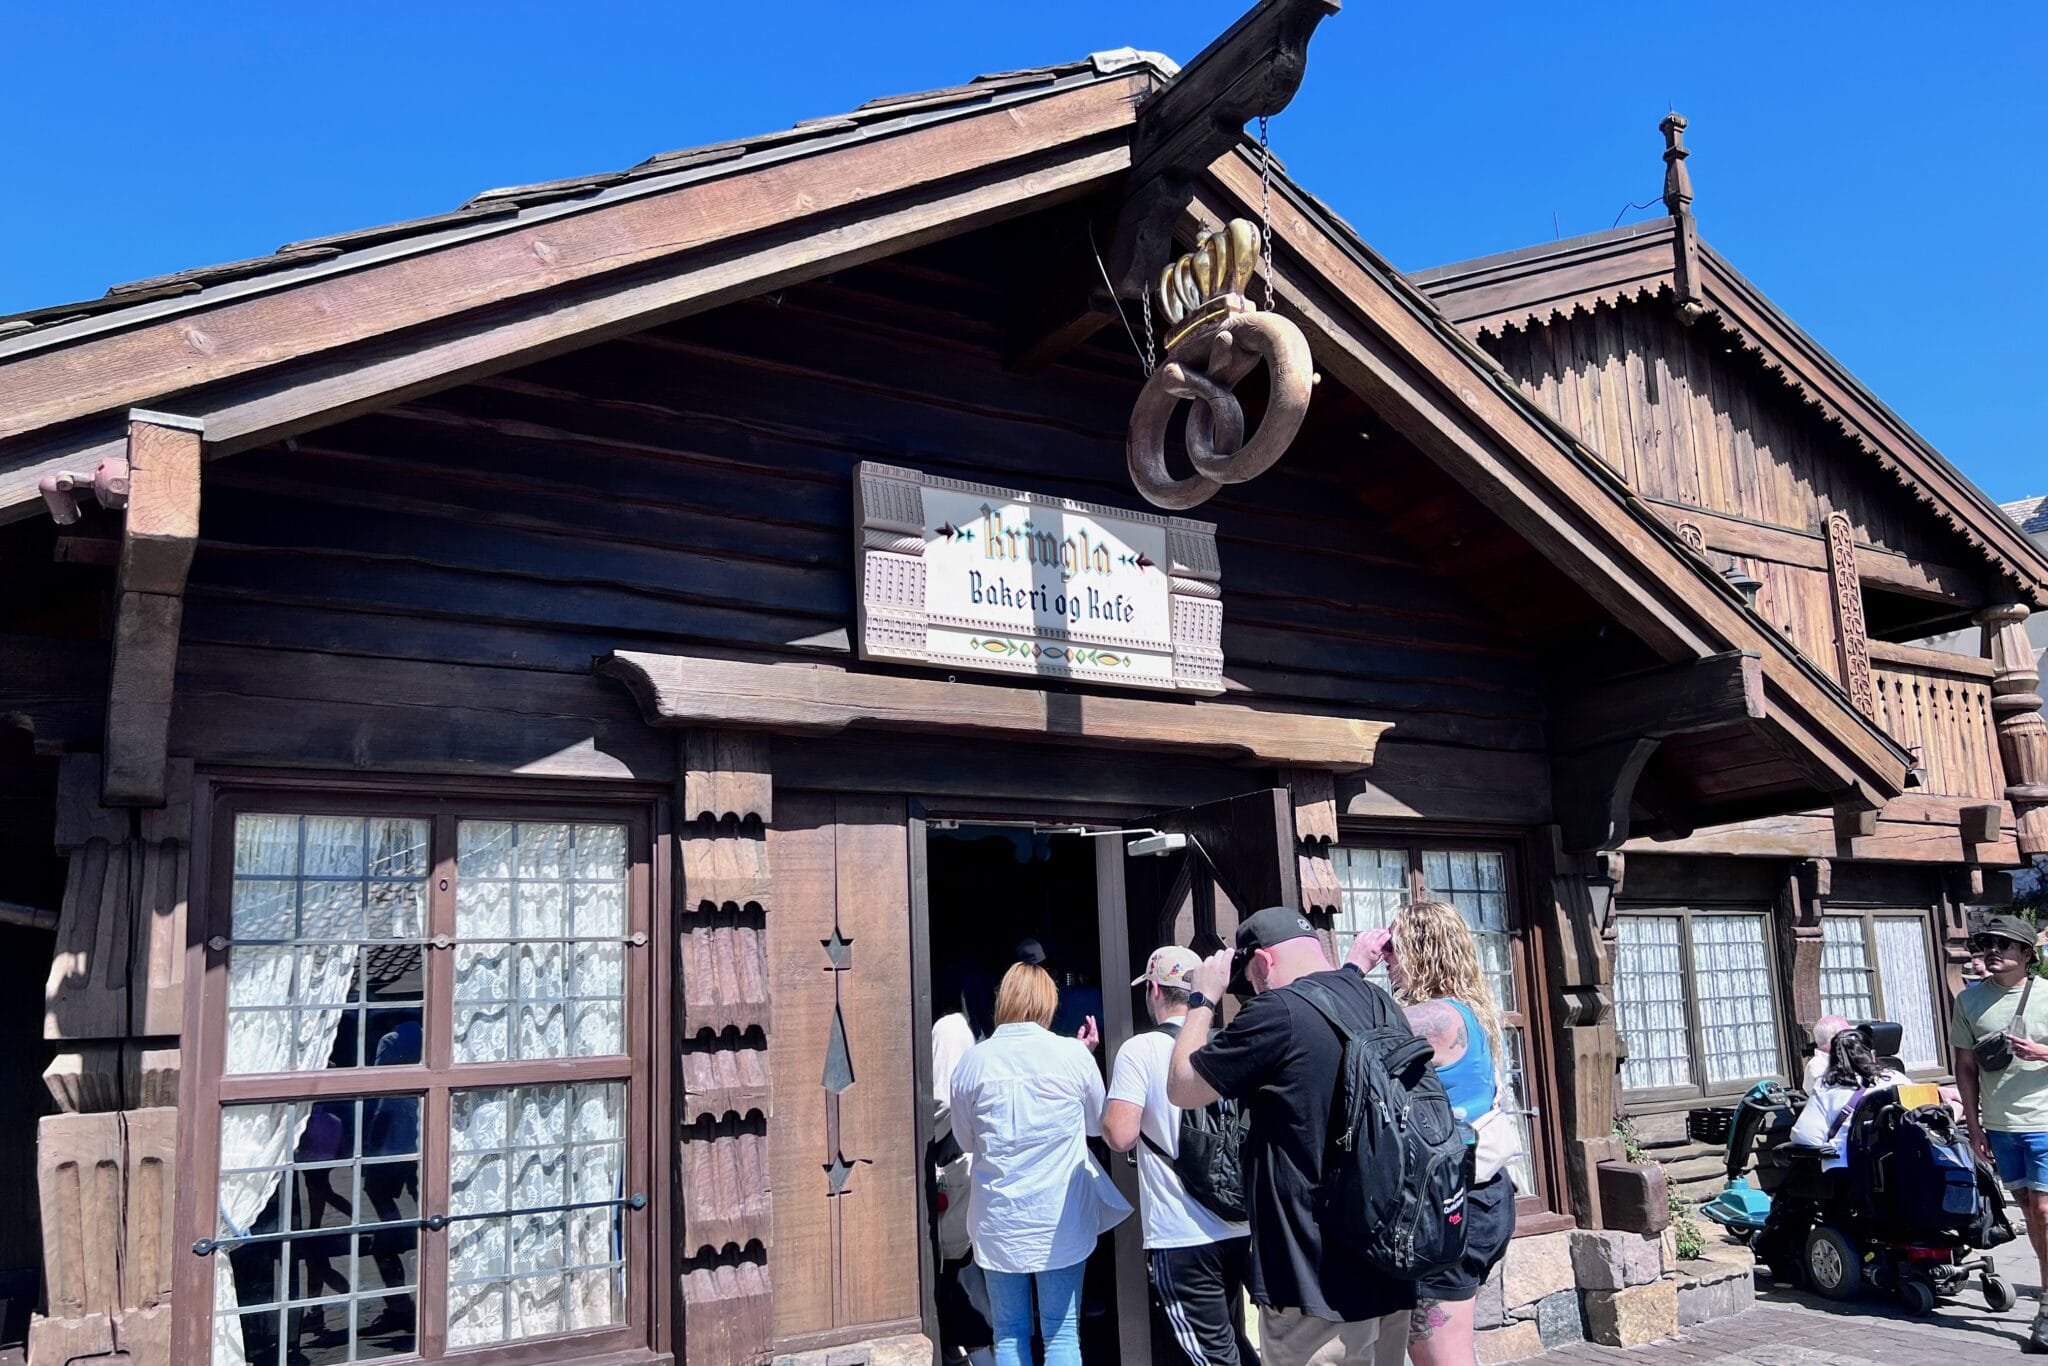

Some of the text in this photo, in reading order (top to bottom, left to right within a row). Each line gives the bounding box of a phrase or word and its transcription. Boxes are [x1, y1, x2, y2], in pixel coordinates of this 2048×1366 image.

[980, 502, 1112, 583] Kringla
[969, 569, 1048, 612] Bakeri
[1055, 594, 1081, 623] og
